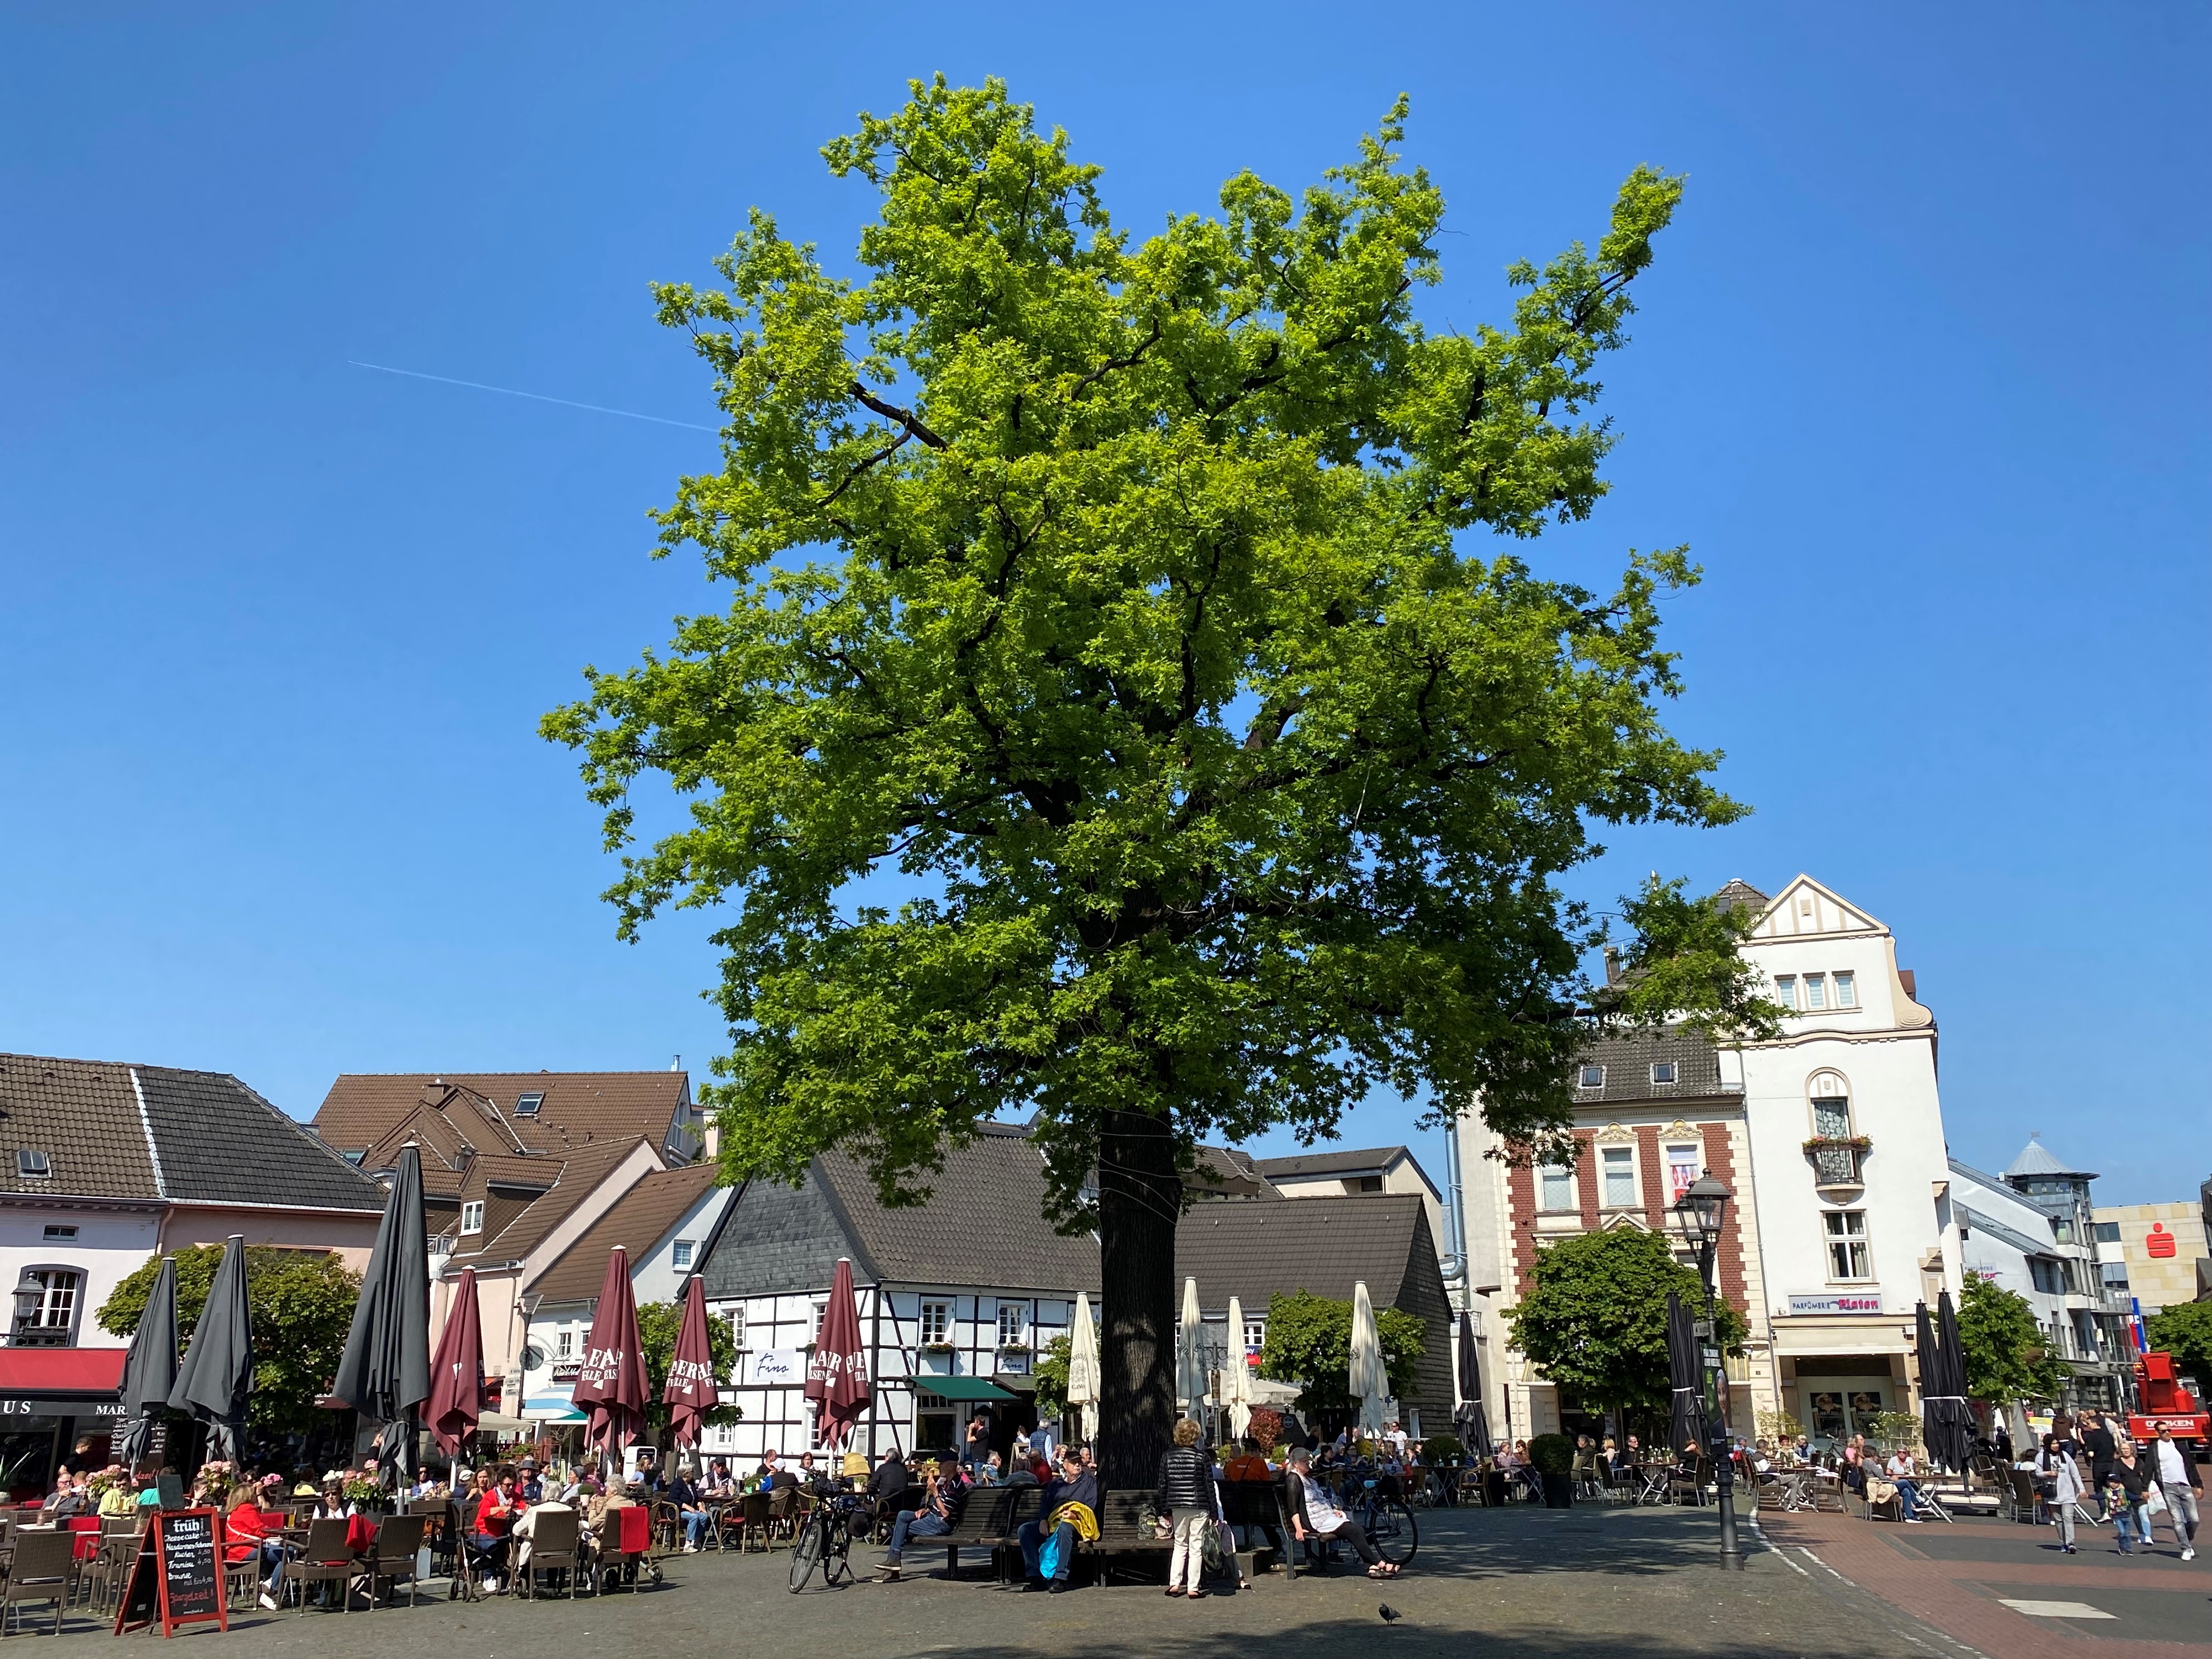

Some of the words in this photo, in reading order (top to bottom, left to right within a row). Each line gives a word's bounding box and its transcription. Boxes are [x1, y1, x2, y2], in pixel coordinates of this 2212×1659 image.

[1792, 1301, 1831, 1310] PARFÜMERIE
[758, 1353, 789, 1378] Fino
[0, 1401, 31, 1414] US
[95, 1404, 128, 1415] MAR
[173, 1517, 200, 1532] früh
[174, 1550, 195, 1559] Kuchen
